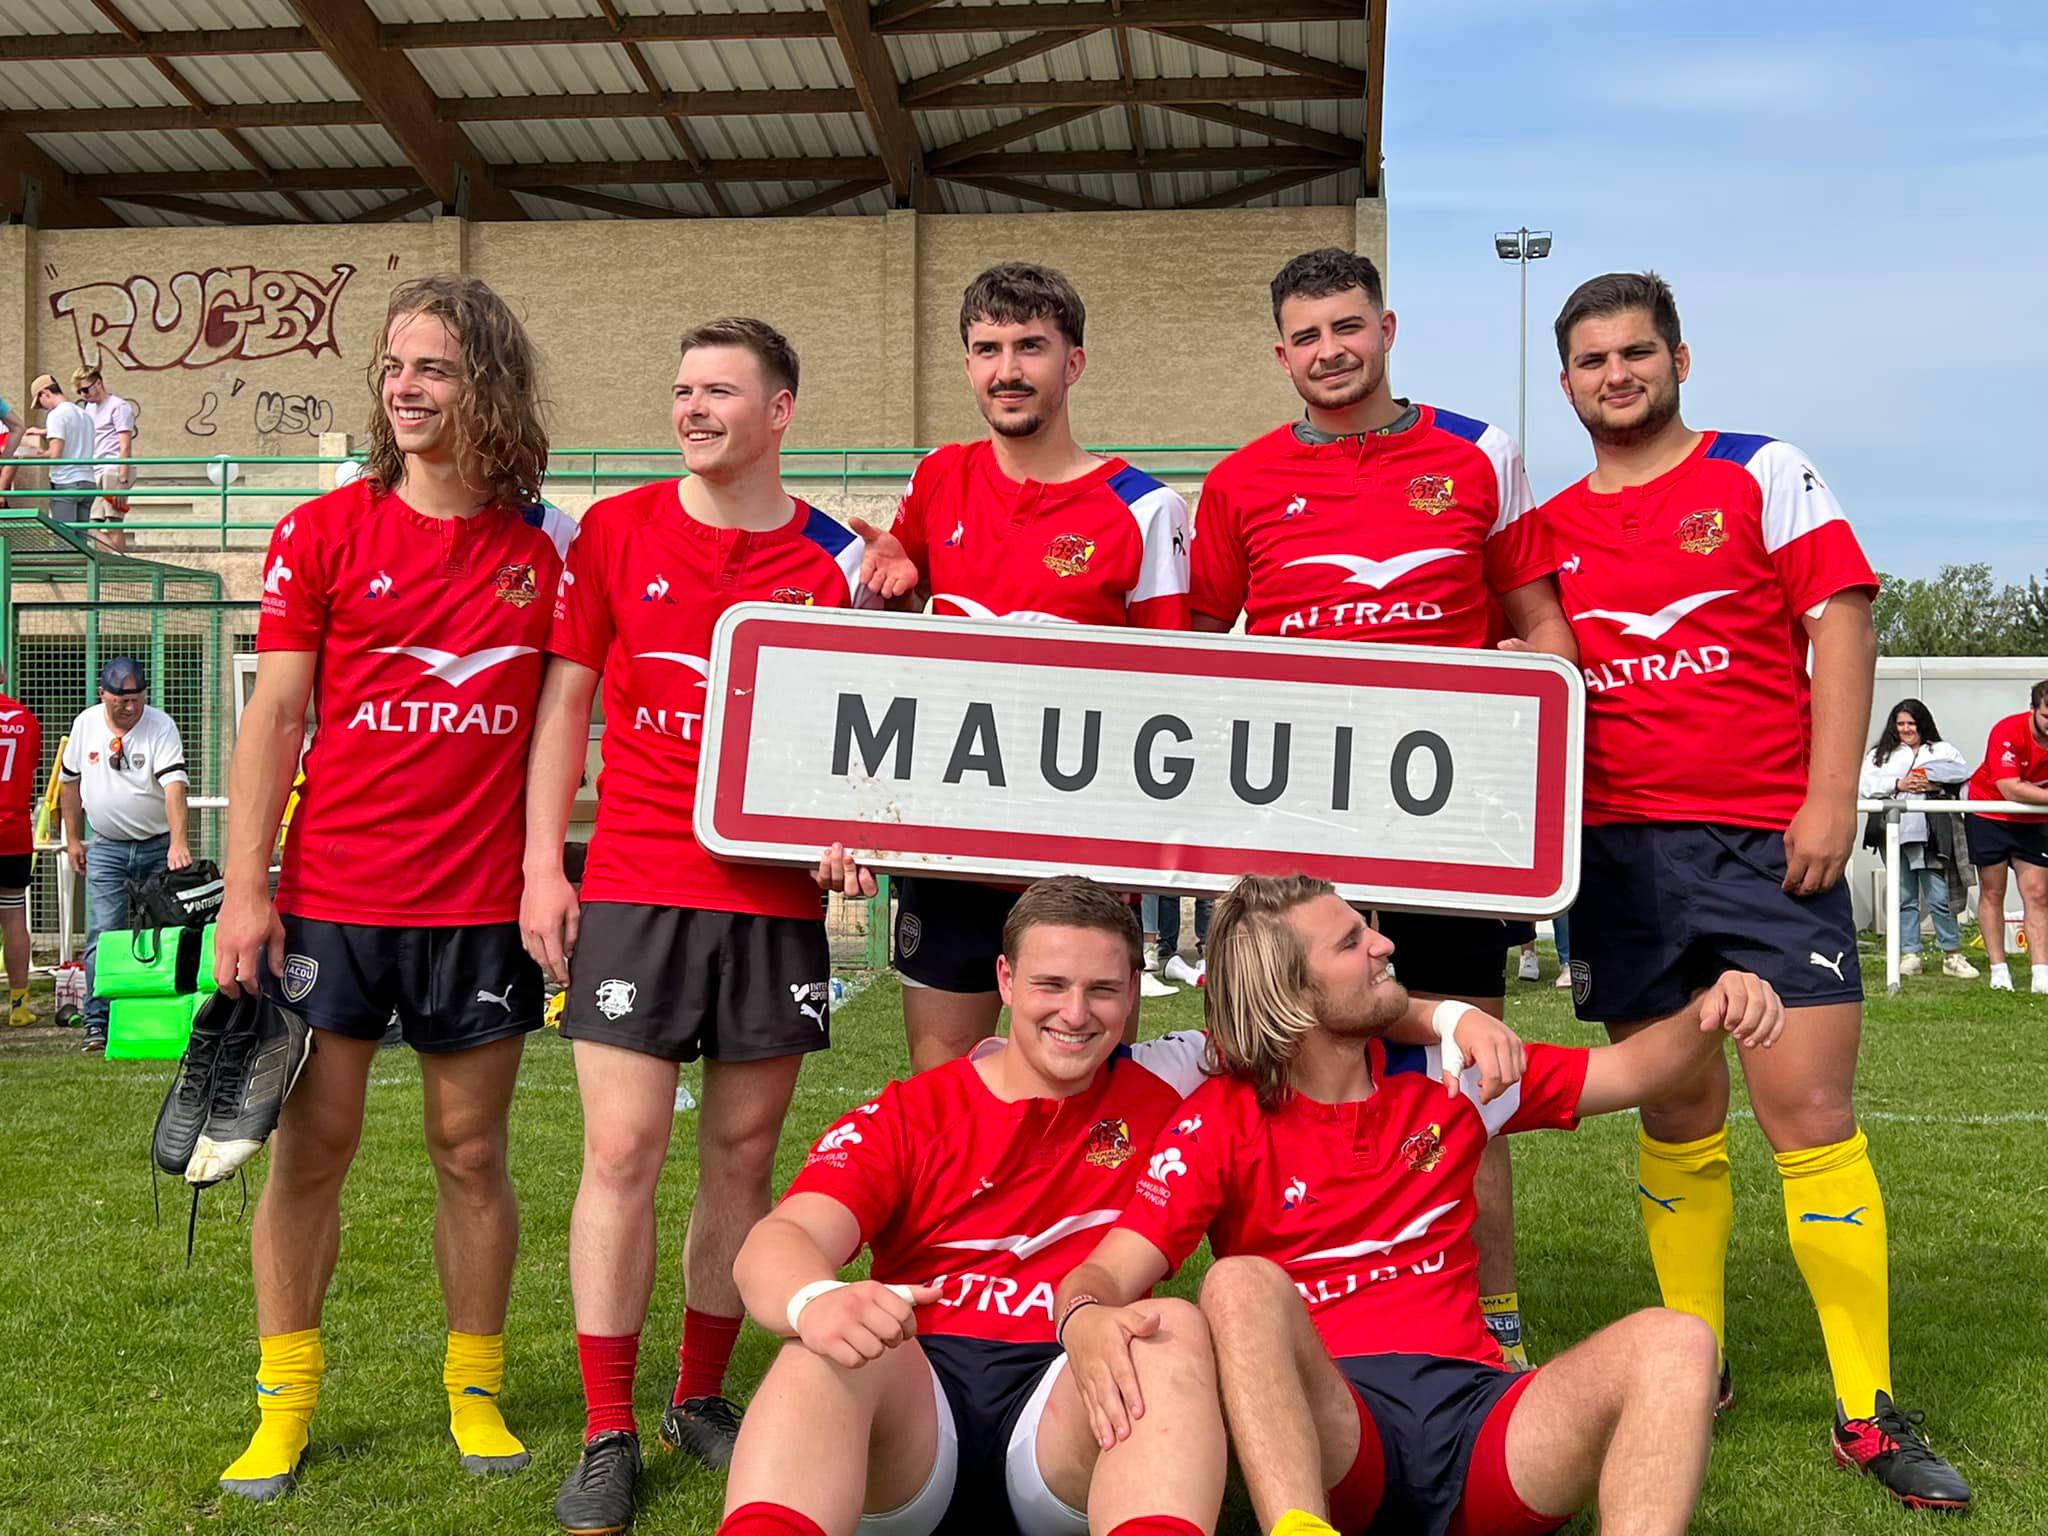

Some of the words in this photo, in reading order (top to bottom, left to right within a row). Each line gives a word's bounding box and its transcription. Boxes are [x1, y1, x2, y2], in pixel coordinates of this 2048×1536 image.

[1279, 601, 1444, 636] ALTRAD
[1584, 645, 1730, 692] ALTRAD
[347, 701, 519, 735] ALTRAD
[633, 706, 702, 741] ALT
[831, 692, 1454, 817] MAUGUIO
[931, 1273, 1055, 1321] LTRA
